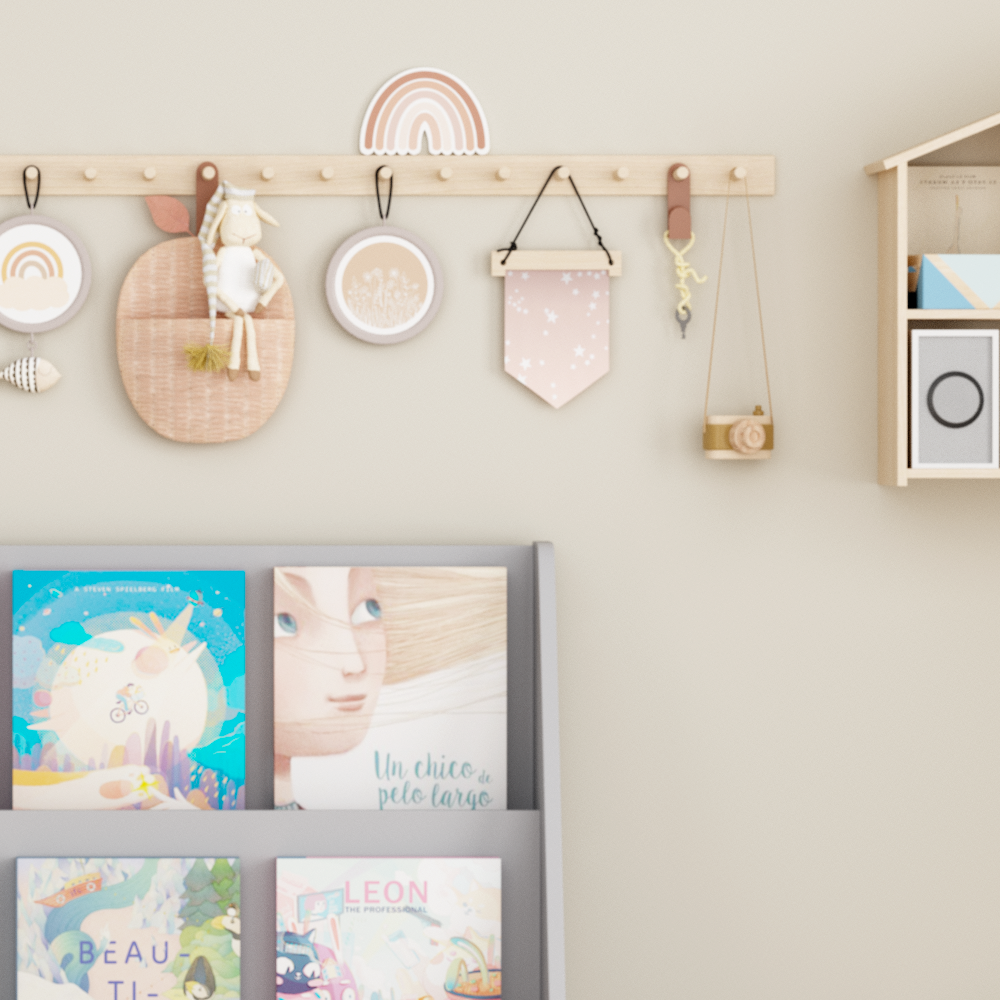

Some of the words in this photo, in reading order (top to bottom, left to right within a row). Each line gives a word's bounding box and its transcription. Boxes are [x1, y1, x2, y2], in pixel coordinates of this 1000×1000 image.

[374, 750, 408, 781] Un
[415, 752, 477, 779] chico
[478, 769, 493, 784] de
[378, 781, 427, 810] pelo
[431, 783, 493, 810] largo
[345, 880, 428, 904] LEON
[79, 941, 190, 964] BEAU-
